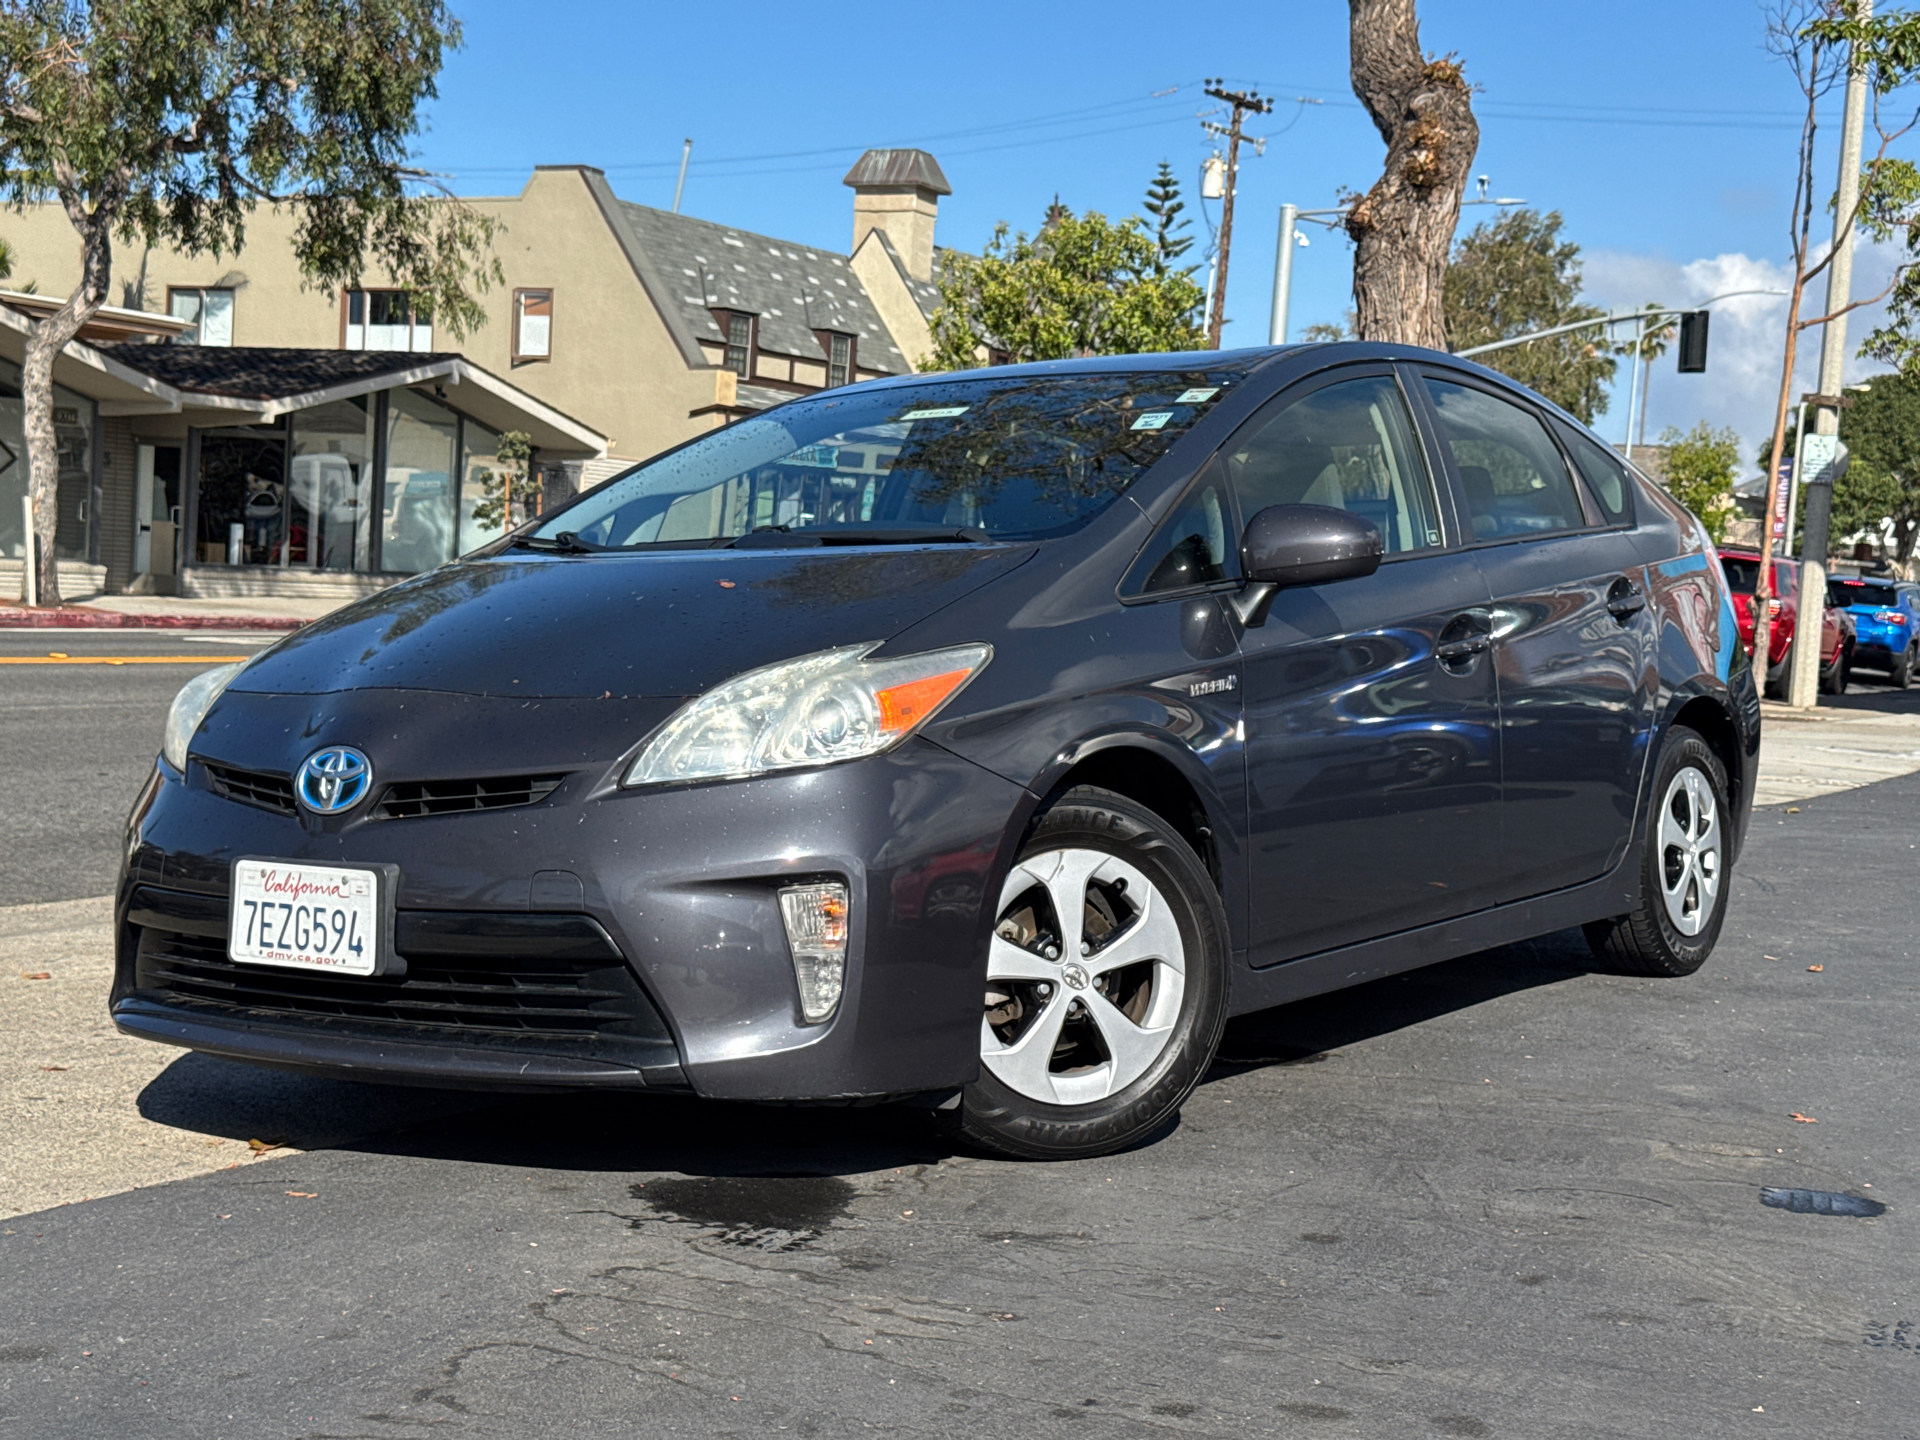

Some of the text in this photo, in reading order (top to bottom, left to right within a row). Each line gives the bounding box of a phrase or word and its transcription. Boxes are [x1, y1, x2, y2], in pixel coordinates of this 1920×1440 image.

[264, 869, 351, 901] California
[244, 900, 363, 957] 7EZG594
[266, 950, 339, 965] dmv.ca.gov
